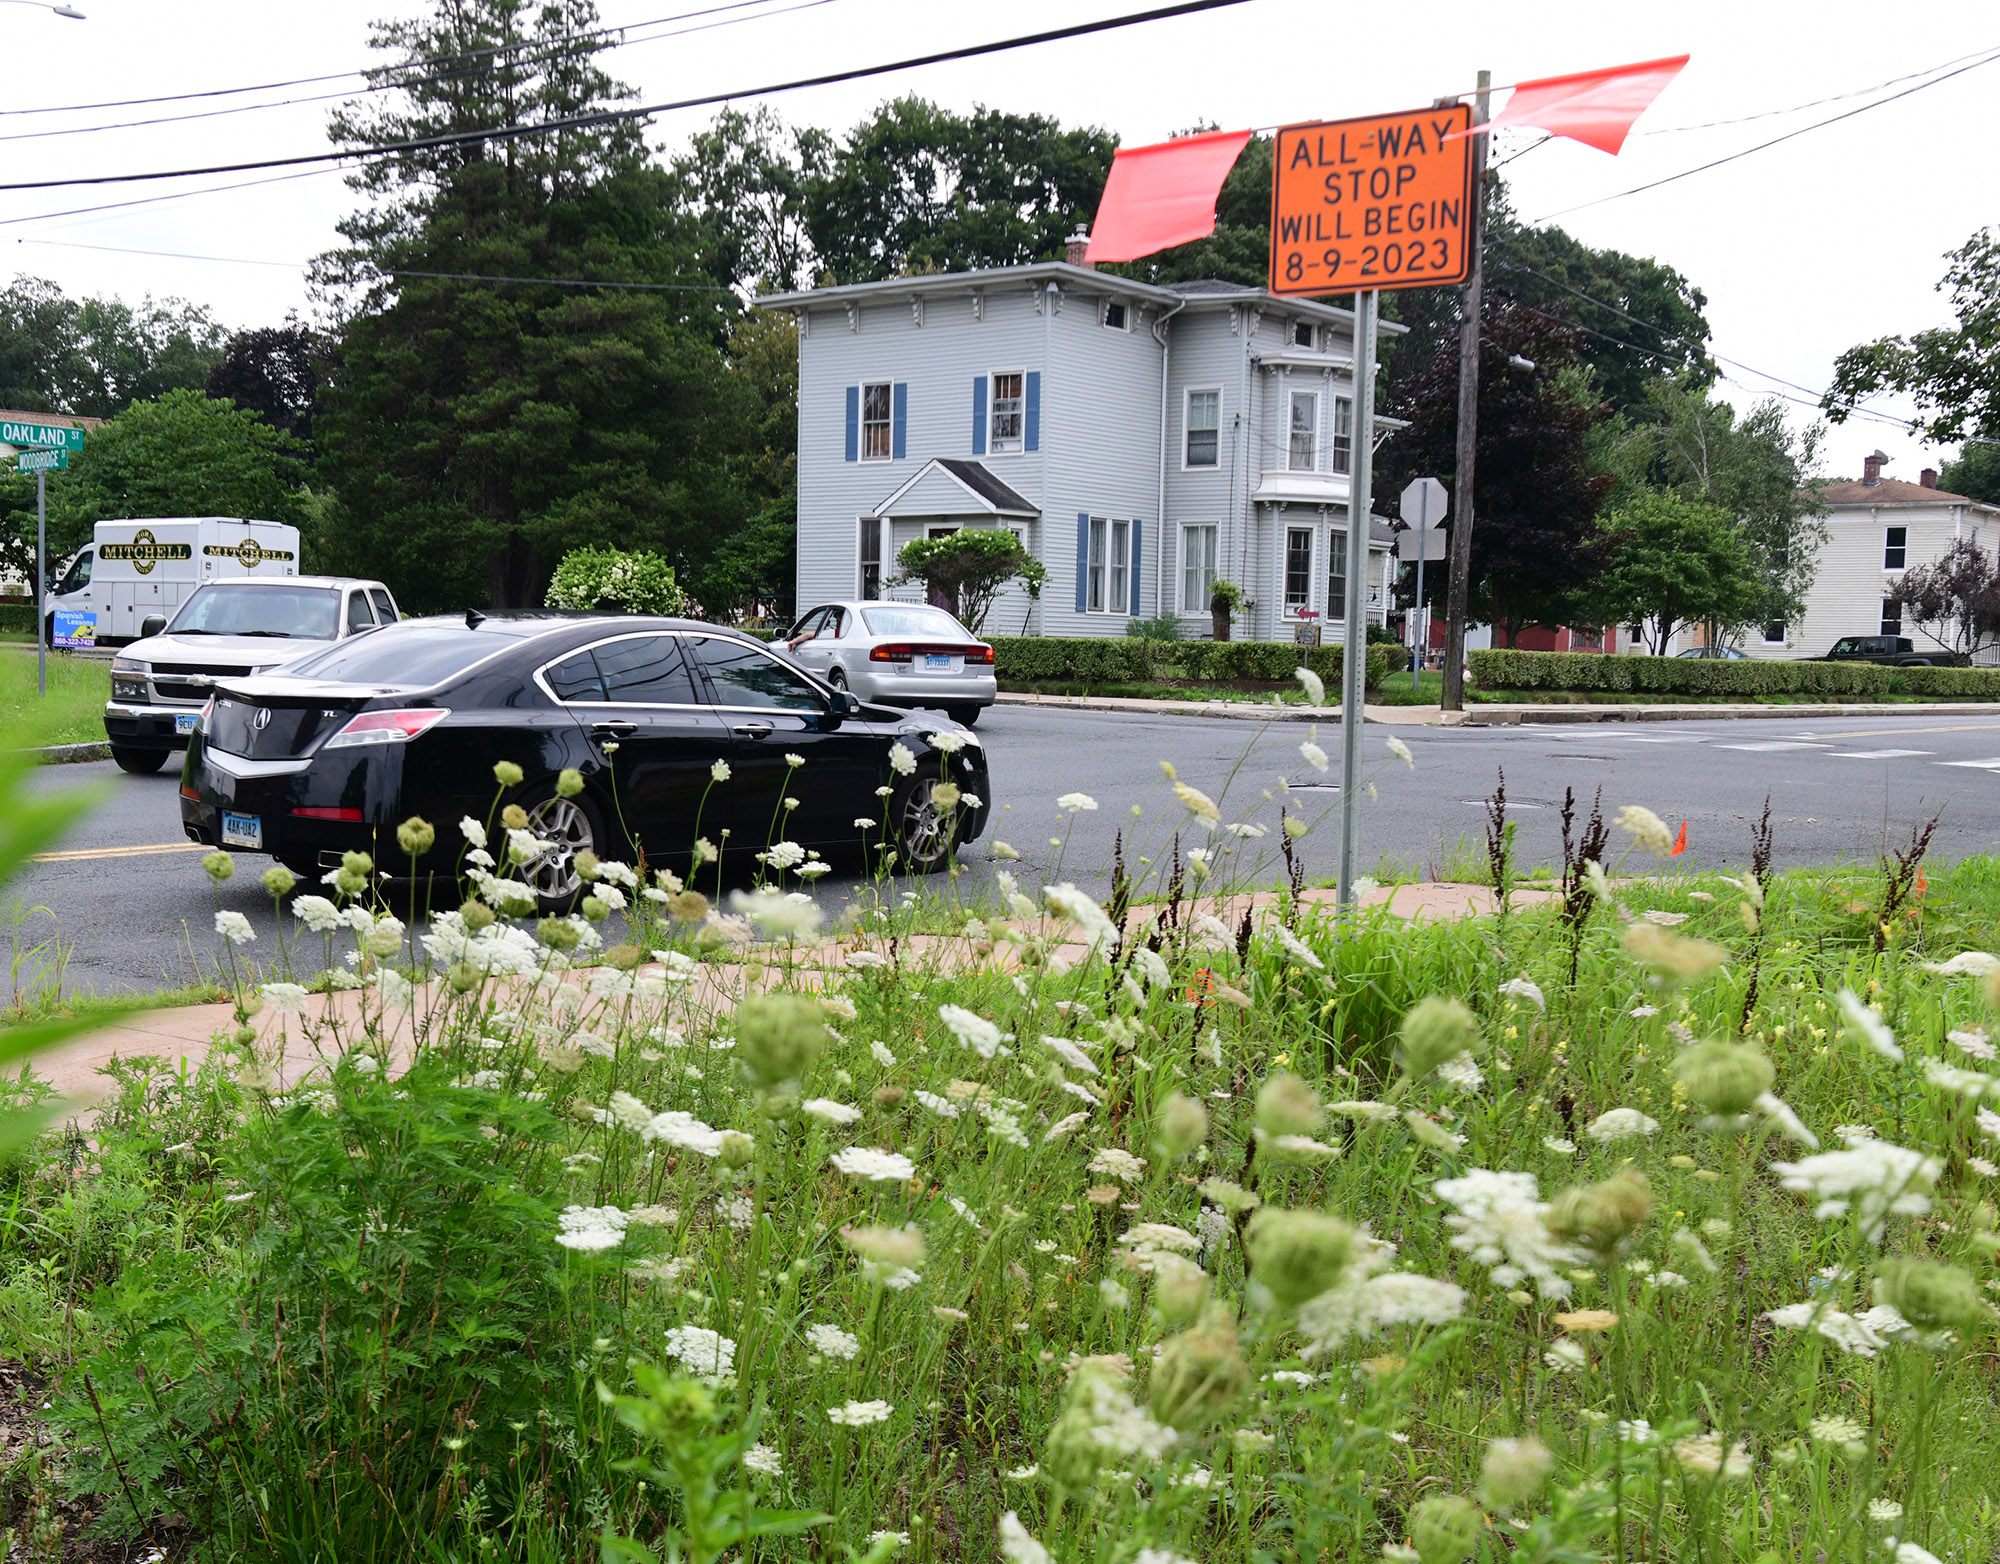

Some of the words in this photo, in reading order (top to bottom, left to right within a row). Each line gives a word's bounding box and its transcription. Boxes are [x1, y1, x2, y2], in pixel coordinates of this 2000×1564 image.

[1290, 118, 1455, 170] ALL-WAY
[1324, 164, 1417, 205] STOP
[1281, 211, 1352, 244] WILL
[1364, 197, 1460, 237] BEGIN
[1286, 238, 1449, 282] 8-9-2023
[3, 423, 66, 446] OAKLAND
[71, 430, 80, 441] ST
[19, 449, 59, 470] WOODBRIDGE
[104, 545, 187, 559] MITCHELL
[208, 546, 290, 561] MITCHELL
[56, 611, 84, 620] Spanish
[67, 618, 94, 626] Lessons
[323, 710, 338, 718] TL
